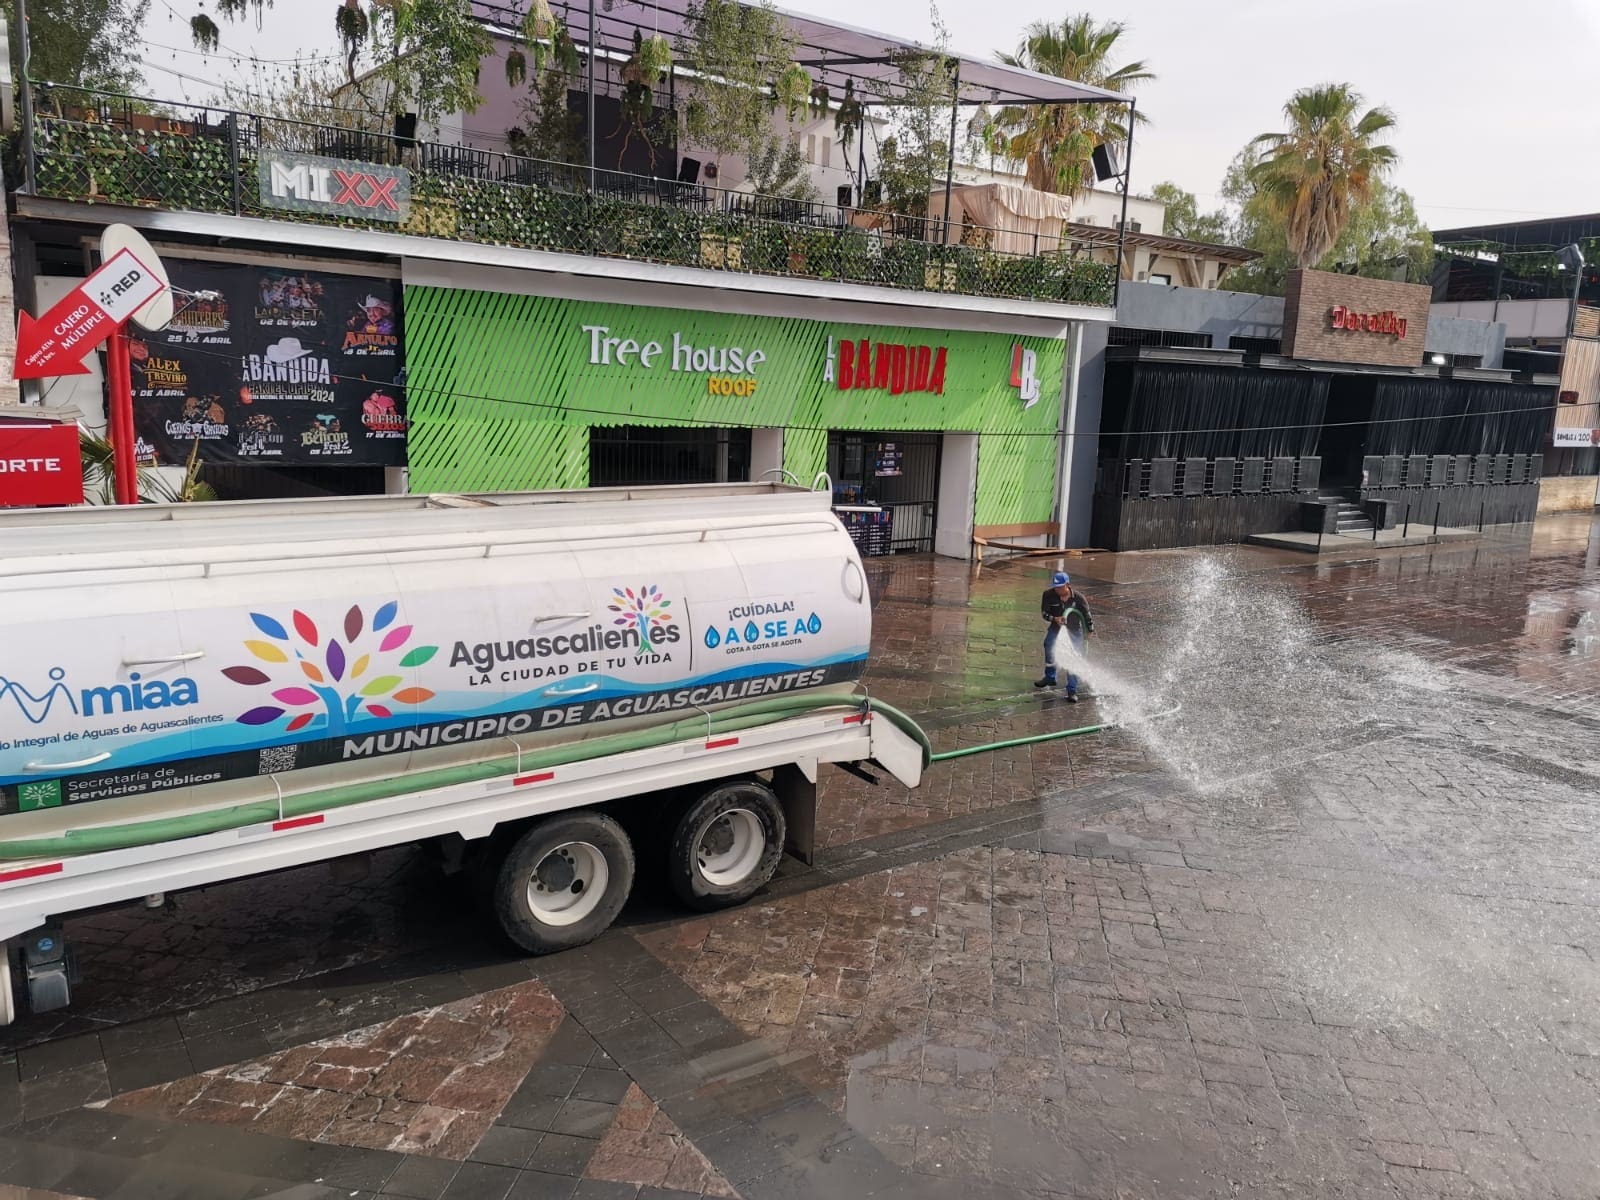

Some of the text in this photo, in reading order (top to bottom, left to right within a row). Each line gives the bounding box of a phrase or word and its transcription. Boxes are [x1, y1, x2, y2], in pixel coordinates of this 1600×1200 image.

[270, 161, 399, 211] MIXX
[111, 270, 141, 296] RED
[54, 305, 89, 335] CAJERO
[60, 310, 105, 350] MÚLTIPLE
[1333, 305, 1407, 339] Dorothy
[24, 339, 56, 366] Cajero ATM
[167, 335, 182, 343] 25
[202, 336, 232, 344] ABRIL
[582, 325, 766, 374] Tree house
[37, 356, 46, 367] 24
[147, 357, 181, 371] ALEX
[249, 354, 330, 384] BANDIDA
[823, 335, 948, 395] LA BANDIDA
[311, 390, 335, 403] 2024
[708, 377, 757, 397] ROOF
[728, 601, 795, 621] ¡CUÍDALA!
[764, 621, 788, 638] SE
[449, 624, 681, 673] Aguascalientes
[726, 644, 744, 654] GOTA
[752, 643, 770, 651] GOTA
[781, 639, 802, 647] AGOTA
[469, 653, 673, 686] LA CIUDAD DE TU VIDA
[82, 672, 199, 717] miaa
[342, 669, 826, 759] MUNICIPIO DE AGUASCALIENTES
[14, 733, 60, 748] Integral
[64, 731, 79, 742] de
[82, 728, 119, 741] Aguas
[122, 723, 137, 734] de
[140, 713, 224, 734] Aguascalientes
[68, 767, 176, 791] Secretaría de
[69, 772, 222, 801] Servicios Públicos
